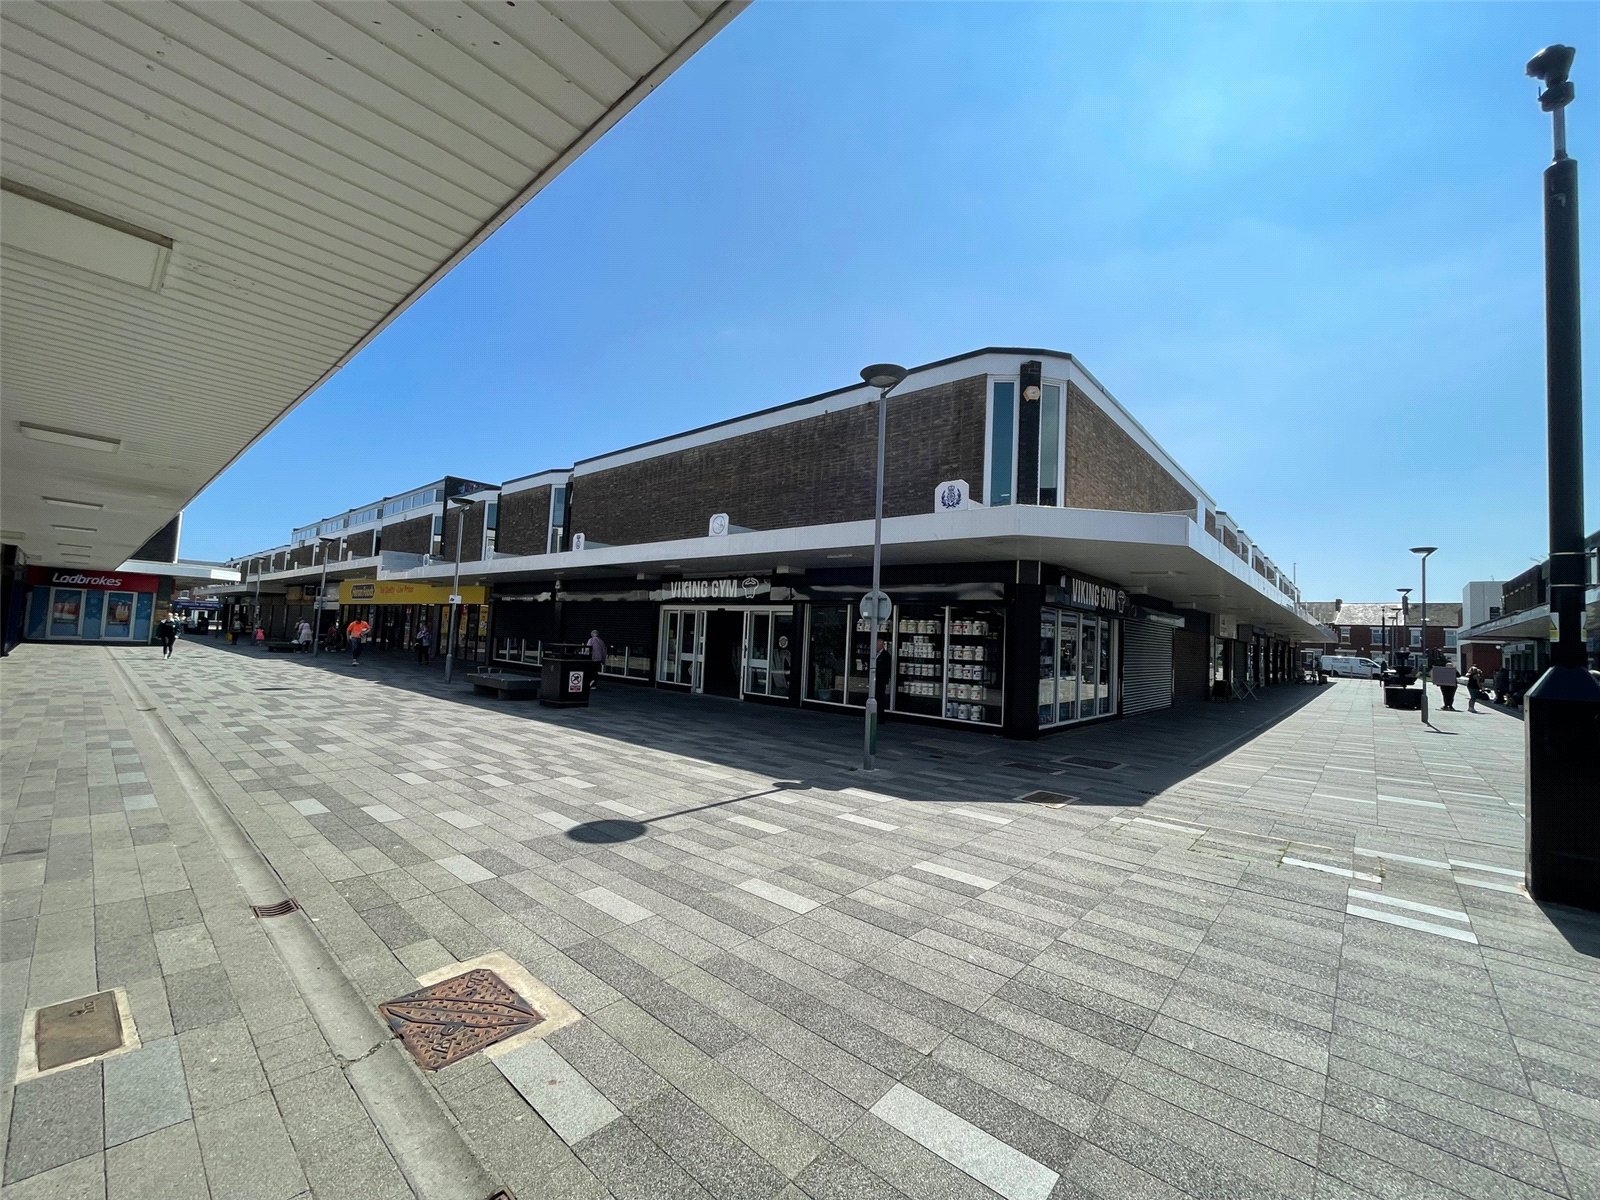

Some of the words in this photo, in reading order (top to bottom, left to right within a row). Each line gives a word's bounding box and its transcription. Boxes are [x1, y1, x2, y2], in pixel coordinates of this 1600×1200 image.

[52, 573, 122, 586] Ladbrokes
[671, 581, 708, 598] VIKING
[711, 580, 738, 598] GYM
[1072, 578, 1100, 607] VIKING
[1100, 586, 1116, 611] GYM
